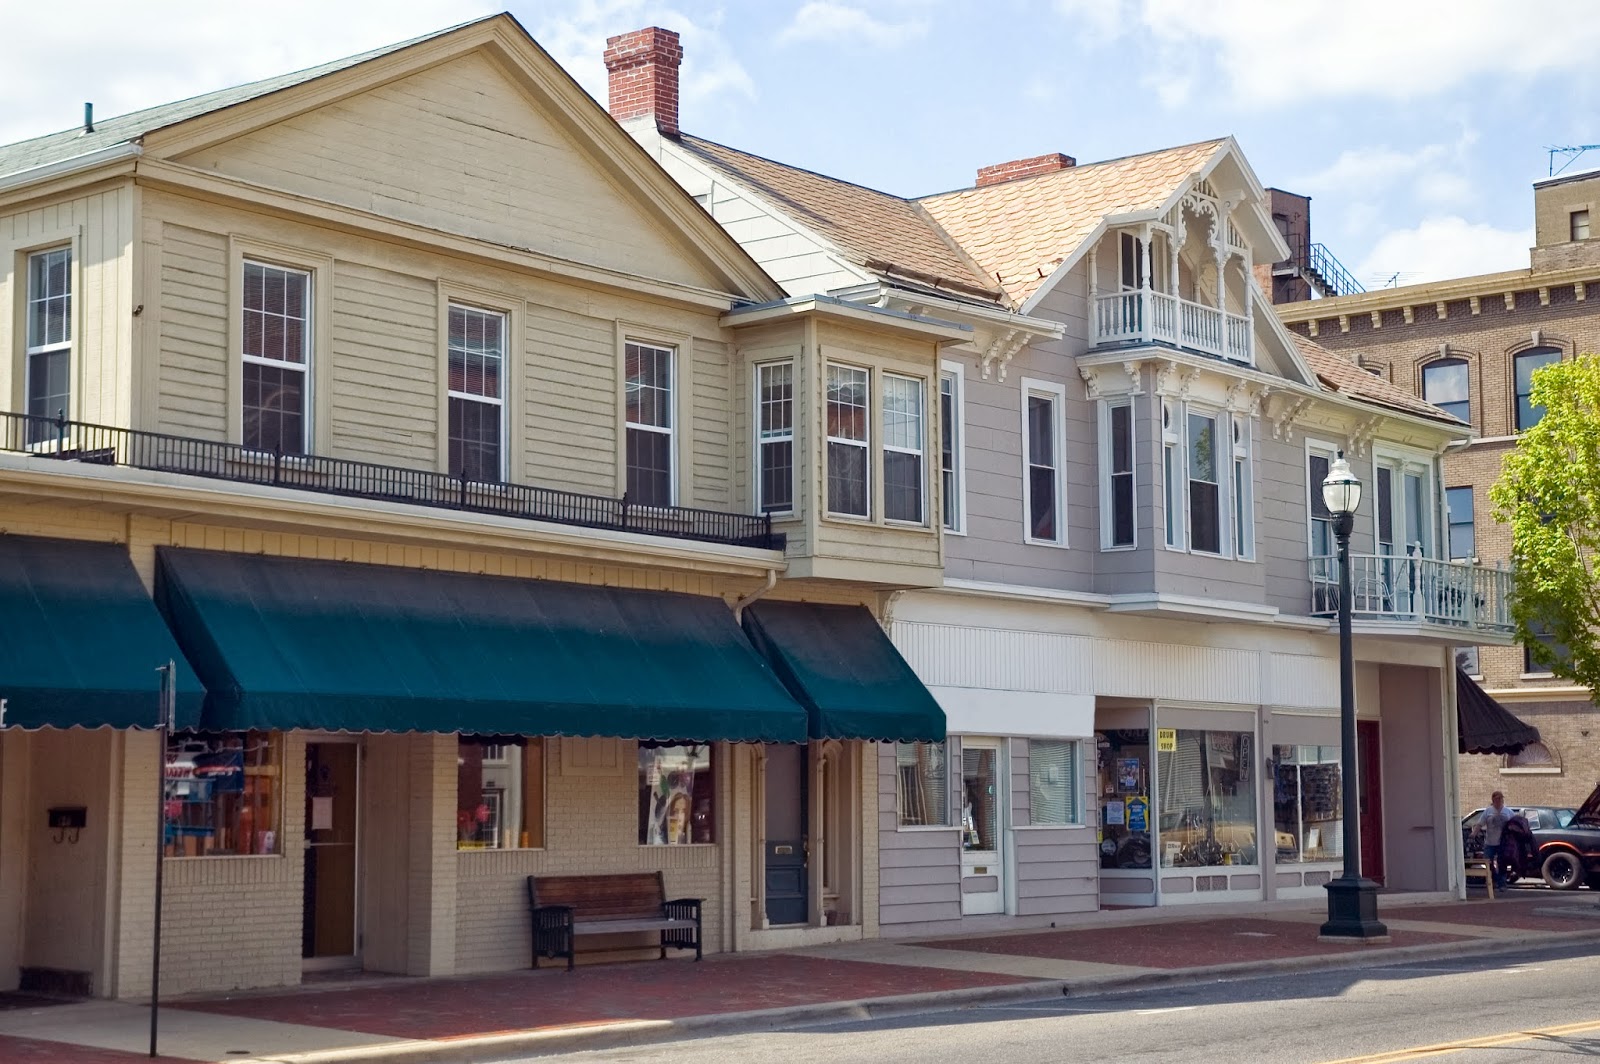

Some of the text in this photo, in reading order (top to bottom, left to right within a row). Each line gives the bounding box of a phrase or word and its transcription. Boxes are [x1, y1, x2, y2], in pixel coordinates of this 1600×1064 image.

[1159, 731, 1174, 739] DRUM
[1160, 742, 1174, 750] SHOP
[1241, 736, 1249, 779] OPEN
